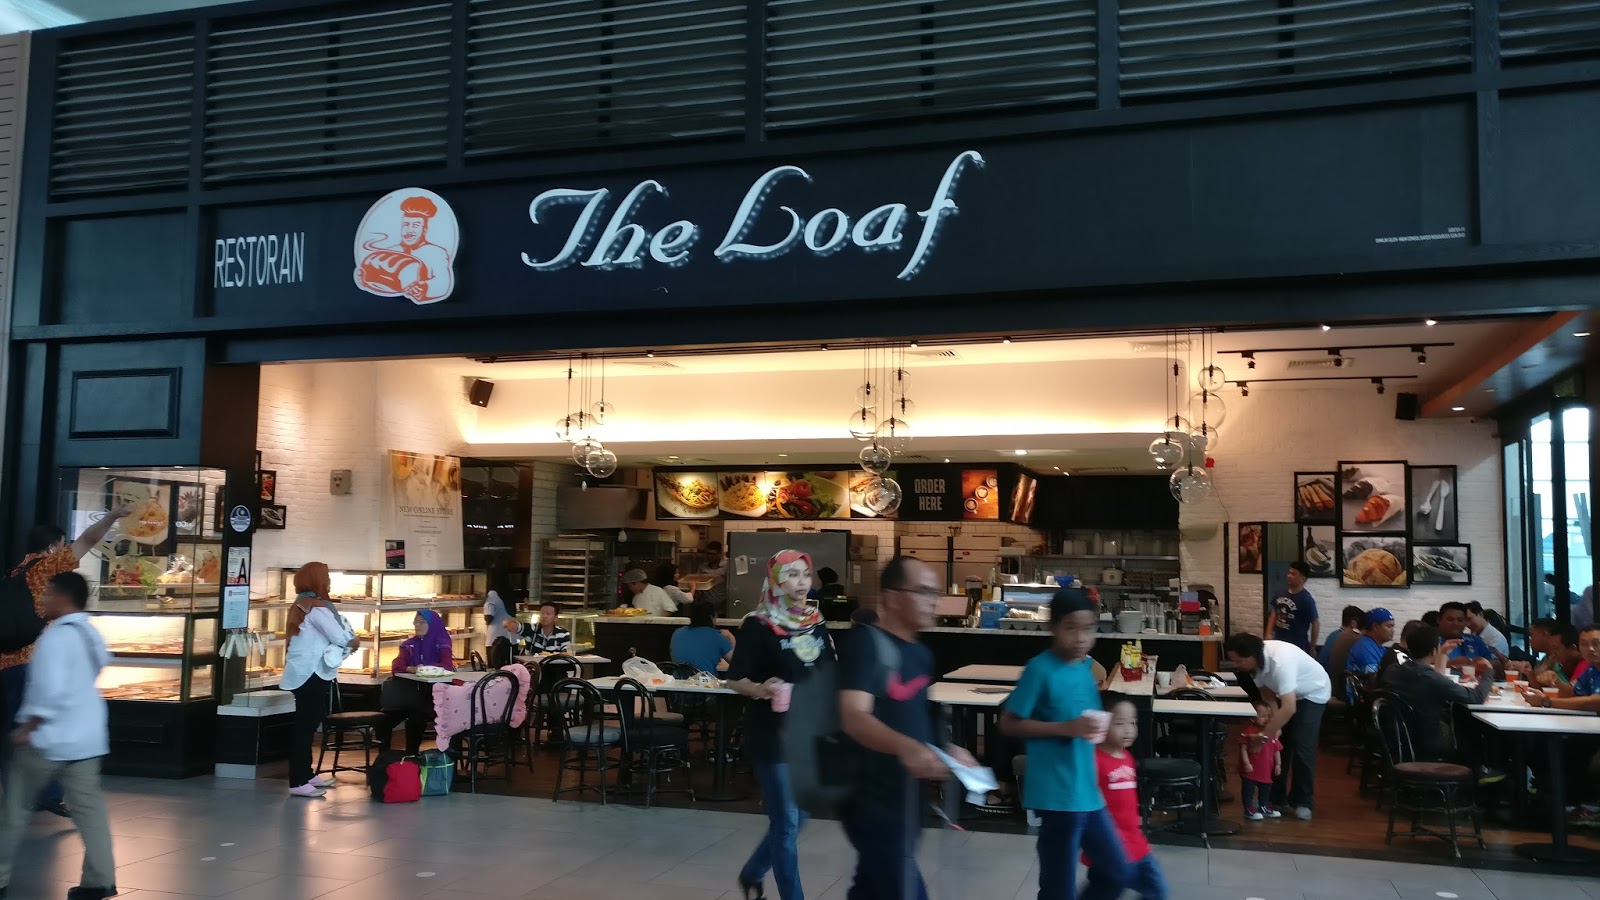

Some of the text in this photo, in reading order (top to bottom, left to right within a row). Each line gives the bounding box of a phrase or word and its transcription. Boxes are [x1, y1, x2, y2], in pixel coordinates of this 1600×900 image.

[520, 150, 986, 281] The Loaf
[213, 231, 305, 288] RESTORAN
[914, 478, 946, 494] ORDER
[398, 505, 454, 516] NEW ONLINE STORE
[918, 495, 943, 511] HERE
[237, 557, 247, 584] A
